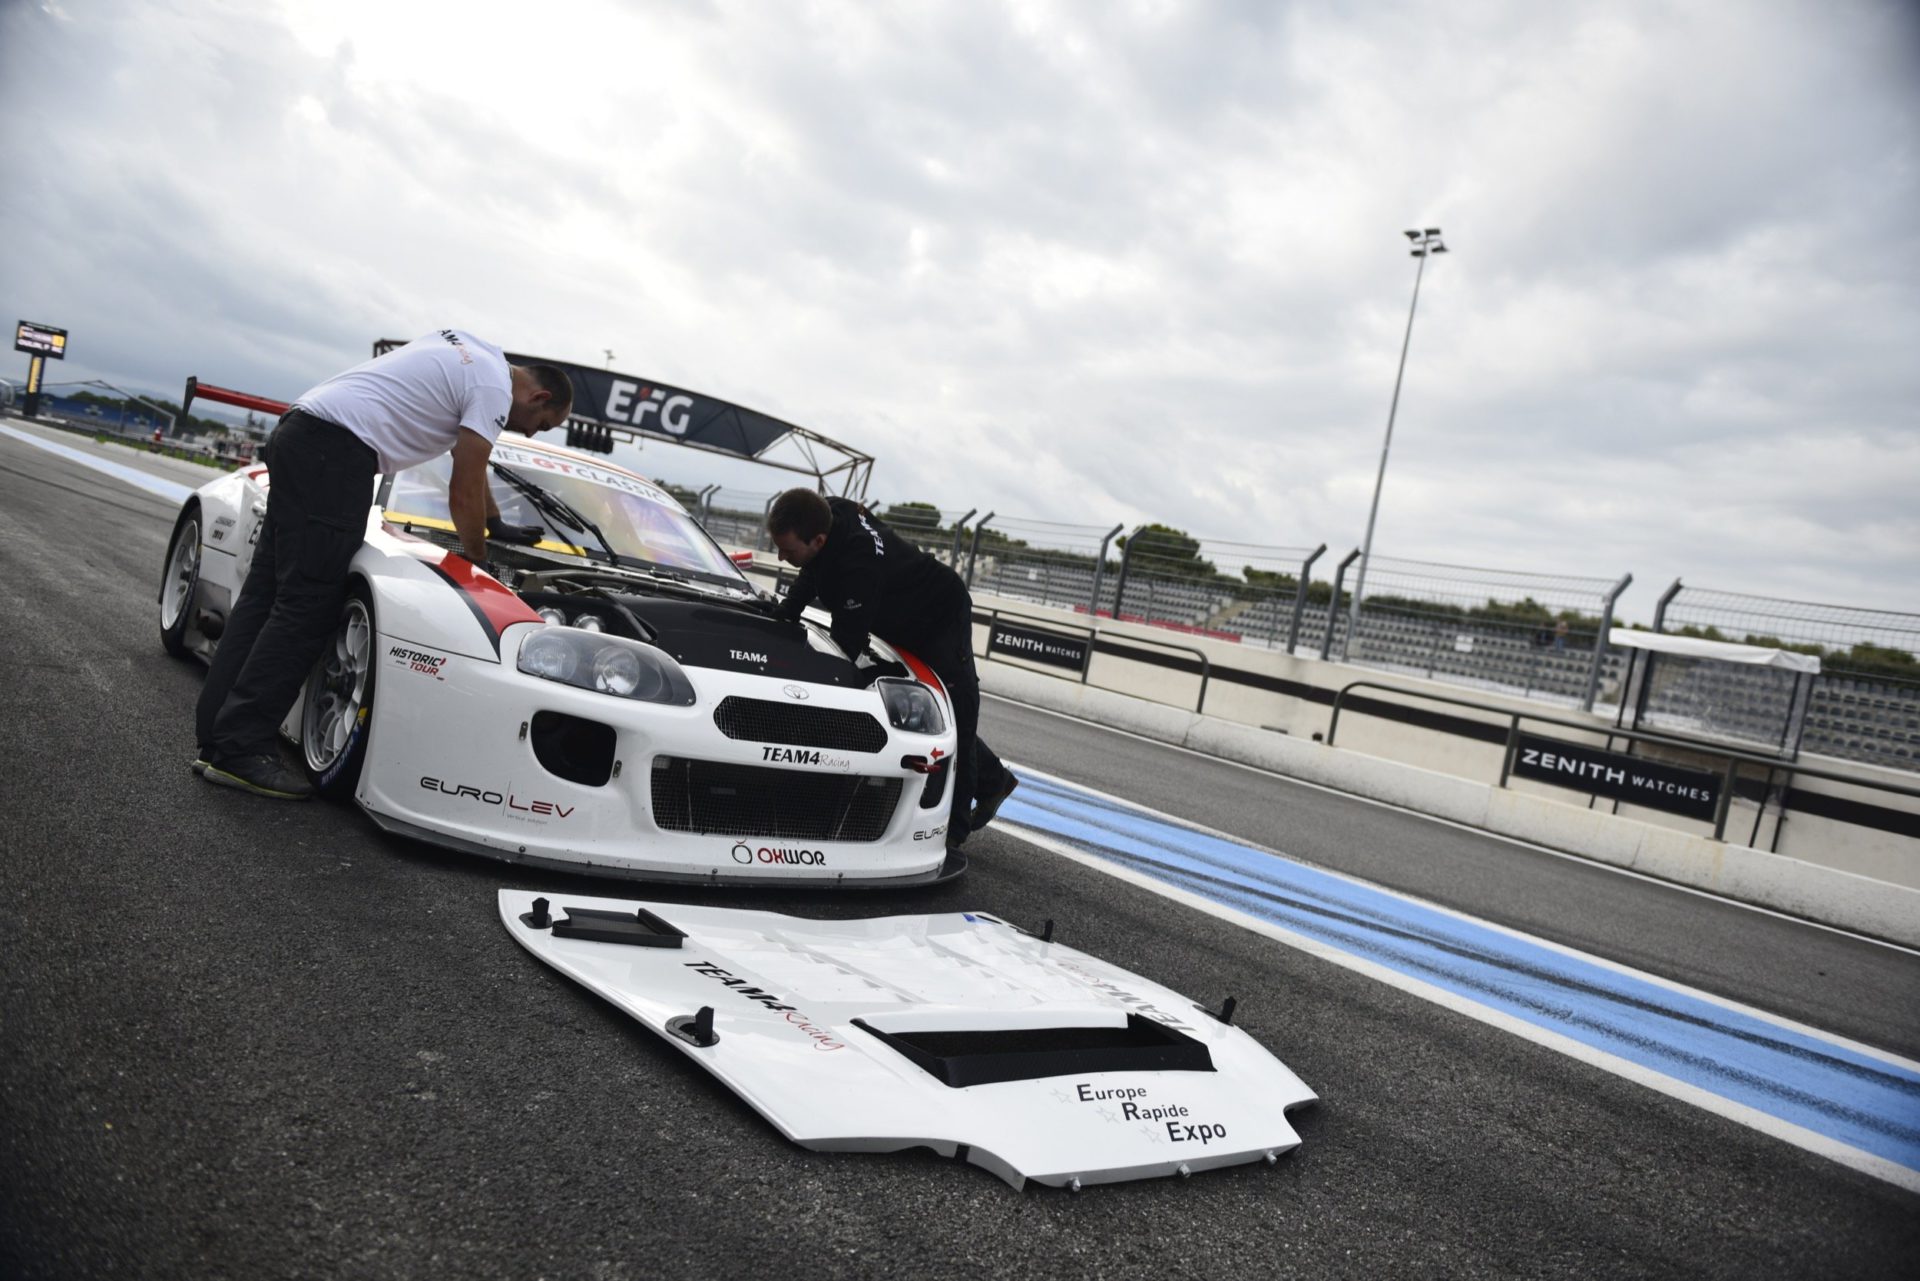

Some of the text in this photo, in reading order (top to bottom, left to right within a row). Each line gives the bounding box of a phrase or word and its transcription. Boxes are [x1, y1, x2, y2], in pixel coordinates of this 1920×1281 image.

[605, 380, 694, 435] EFG
[389, 646, 442, 668] HISTORIC
[729, 649, 768, 664] TEAM4
[995, 632, 1081, 660] ZENITH WATCHES
[409, 661, 440, 676] TOUR
[1521, 749, 1710, 802] ZENITH WATCHES
[1076, 1083, 1148, 1102] Europe
[1121, 1101, 1189, 1122] Rapide
[1166, 1121, 1228, 1145] Expo
